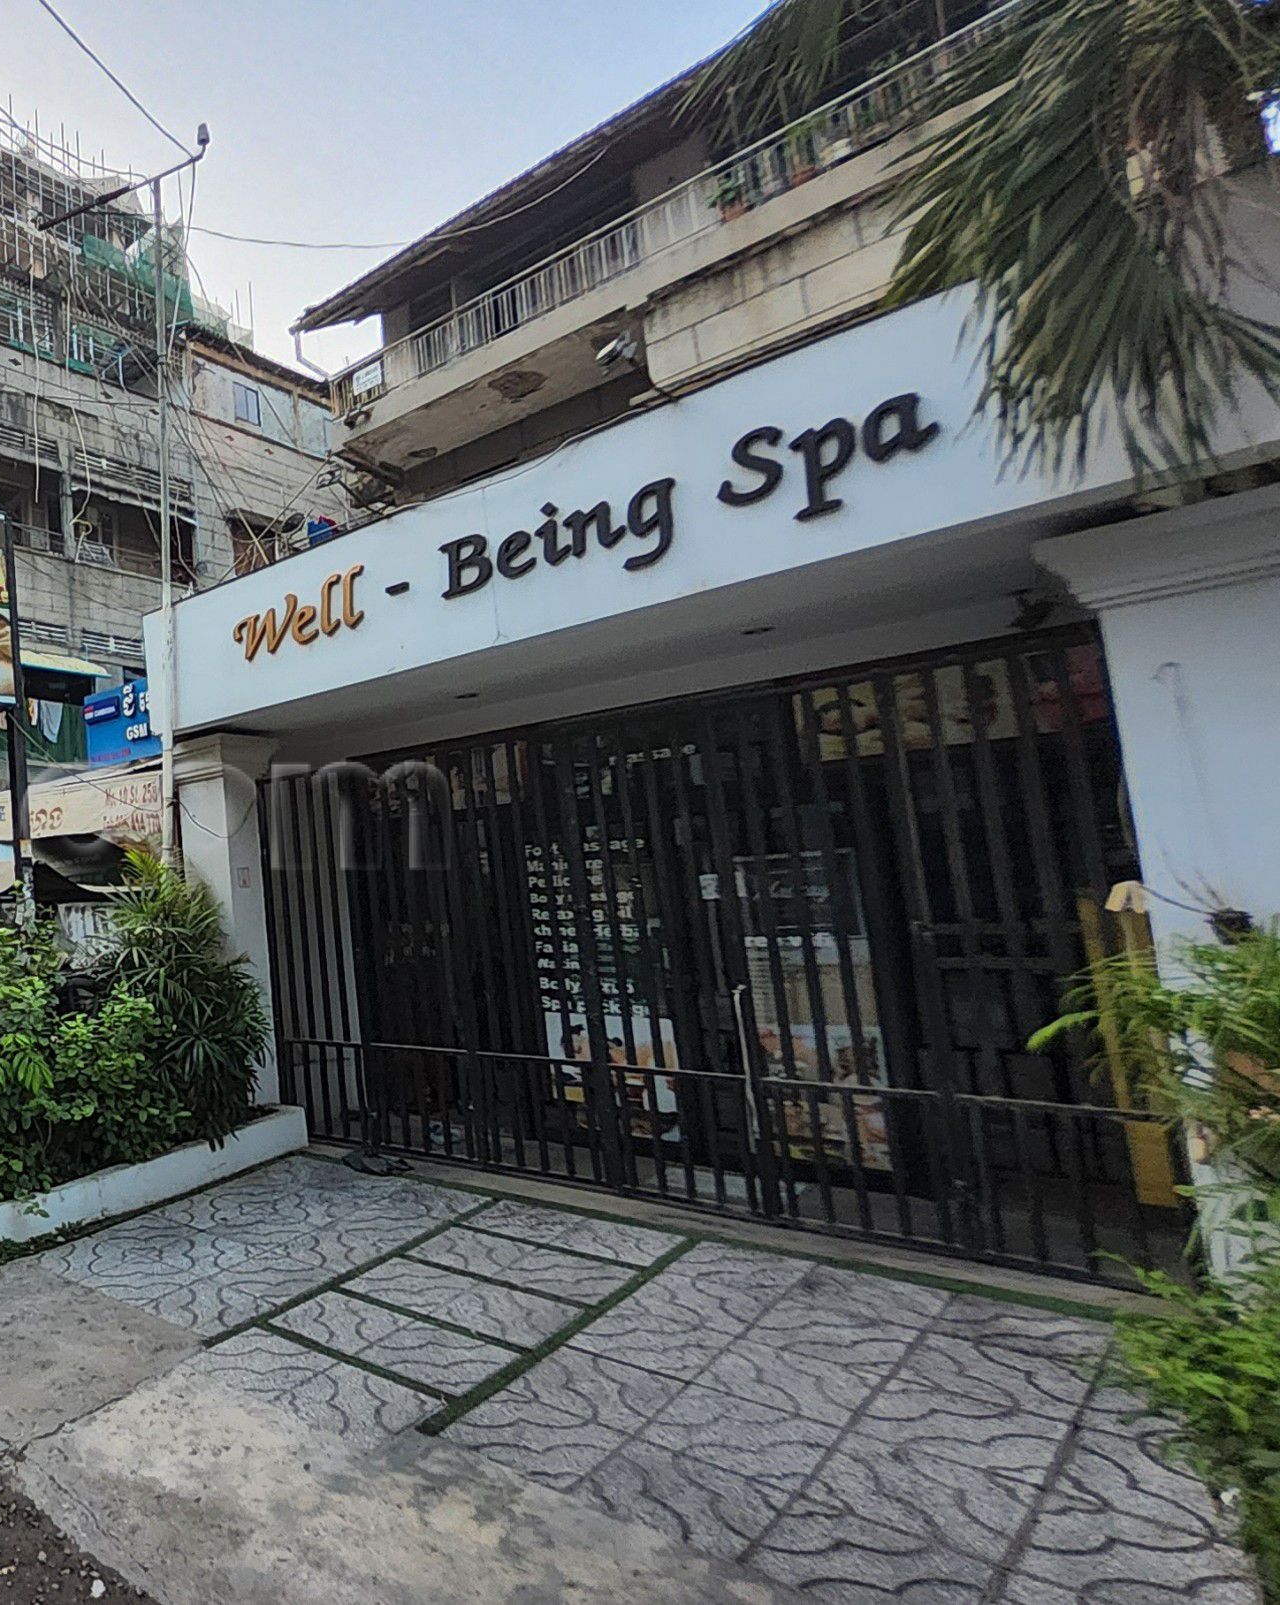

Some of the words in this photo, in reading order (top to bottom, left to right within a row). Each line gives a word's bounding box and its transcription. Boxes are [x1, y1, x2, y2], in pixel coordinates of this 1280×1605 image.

[233, 562, 365, 663] Well
[439, 476, 676, 601] Being
[716, 391, 941, 523] Spa
[126, 723, 149, 741] GSM
